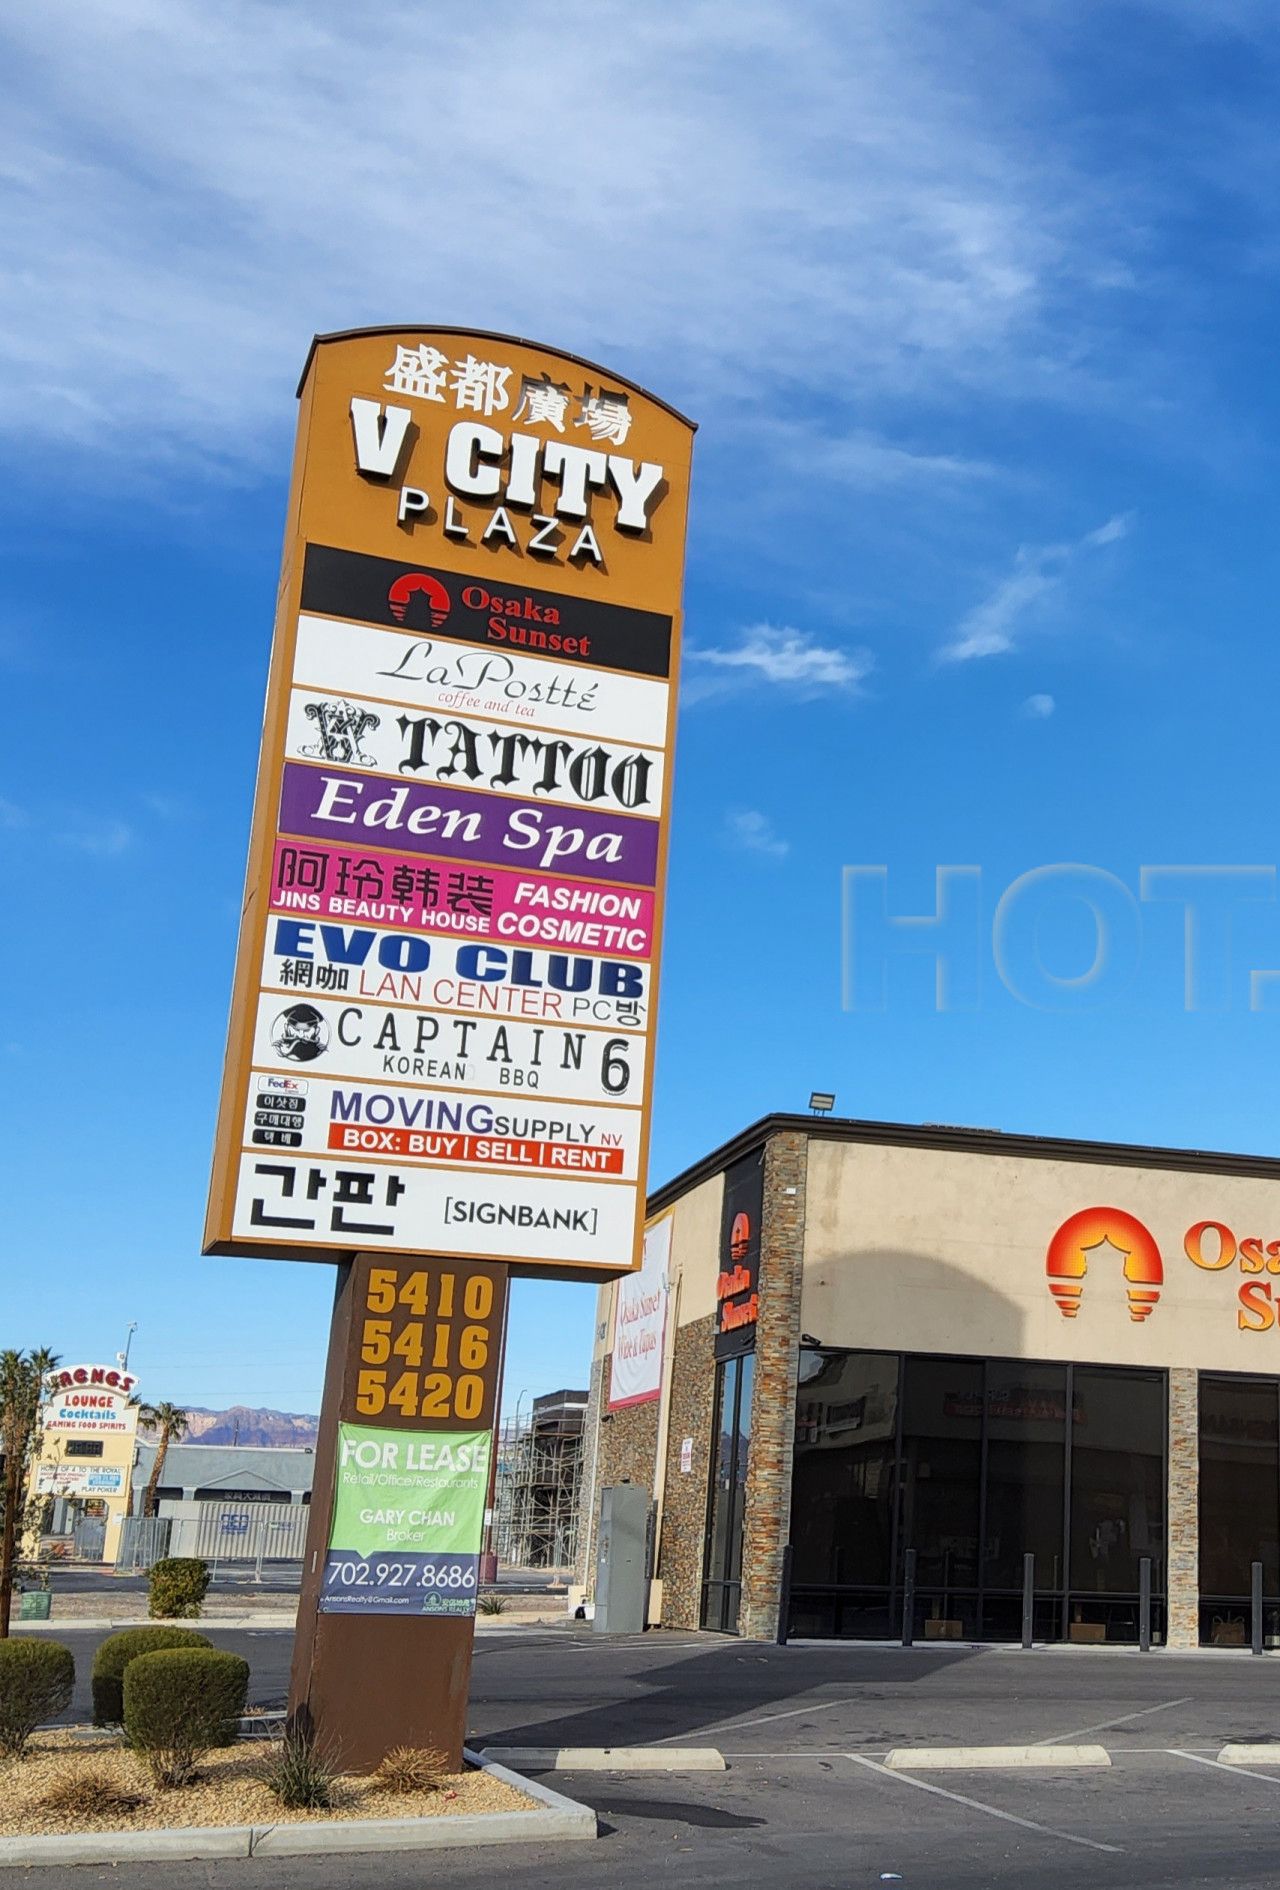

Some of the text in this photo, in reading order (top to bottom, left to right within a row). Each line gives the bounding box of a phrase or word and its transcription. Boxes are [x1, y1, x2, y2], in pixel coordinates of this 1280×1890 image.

[383, 343, 633, 446] 盛都廣場
[350, 397, 664, 534] V CITY
[398, 486, 603, 565] PLAZA
[461, 586, 561, 626] Osaka
[487, 617, 592, 657] Sunset
[438, 690, 535, 718] coffee and tea
[396, 712, 653, 809] TATTOO
[311, 776, 623, 868] Eden Spa
[272, 890, 491, 935] JINS BEAUTY HOUSE
[513, 882, 642, 920] FASHION
[498, 912, 648, 952] COSMETIC
[273, 919, 644, 999] EVO CLUB
[280, 958, 349, 991] 網咖
[359, 970, 563, 1019] LAN CENTER
[337, 1007, 631, 1096] CAPTAIN 6
[268, 1078, 299, 1090] FedEx
[383, 1054, 540, 1090] KOREAN BBQ
[343, 1129, 612, 1170] BOX: BUY SELL RENT
[600, 1133, 623, 1147] NV
[250, 1163, 405, 1236] 간판
[366, 1268, 494, 1321] 5410
[361, 1319, 490, 1370] 5416
[59, 1409, 116, 1420] Cocktails
[64, 1395, 114, 1408] LOUNGE
[356, 1369, 485, 1421] 5420
[47, 1420, 127, 1430] GAMING FOOD SPIRITS
[341, 1439, 488, 1473] FOR LEASE
[359, 1509, 455, 1526] GARY CHAN
[386, 1529, 426, 1542] Broker
[328, 1562, 475, 1588] 702.927.8686
